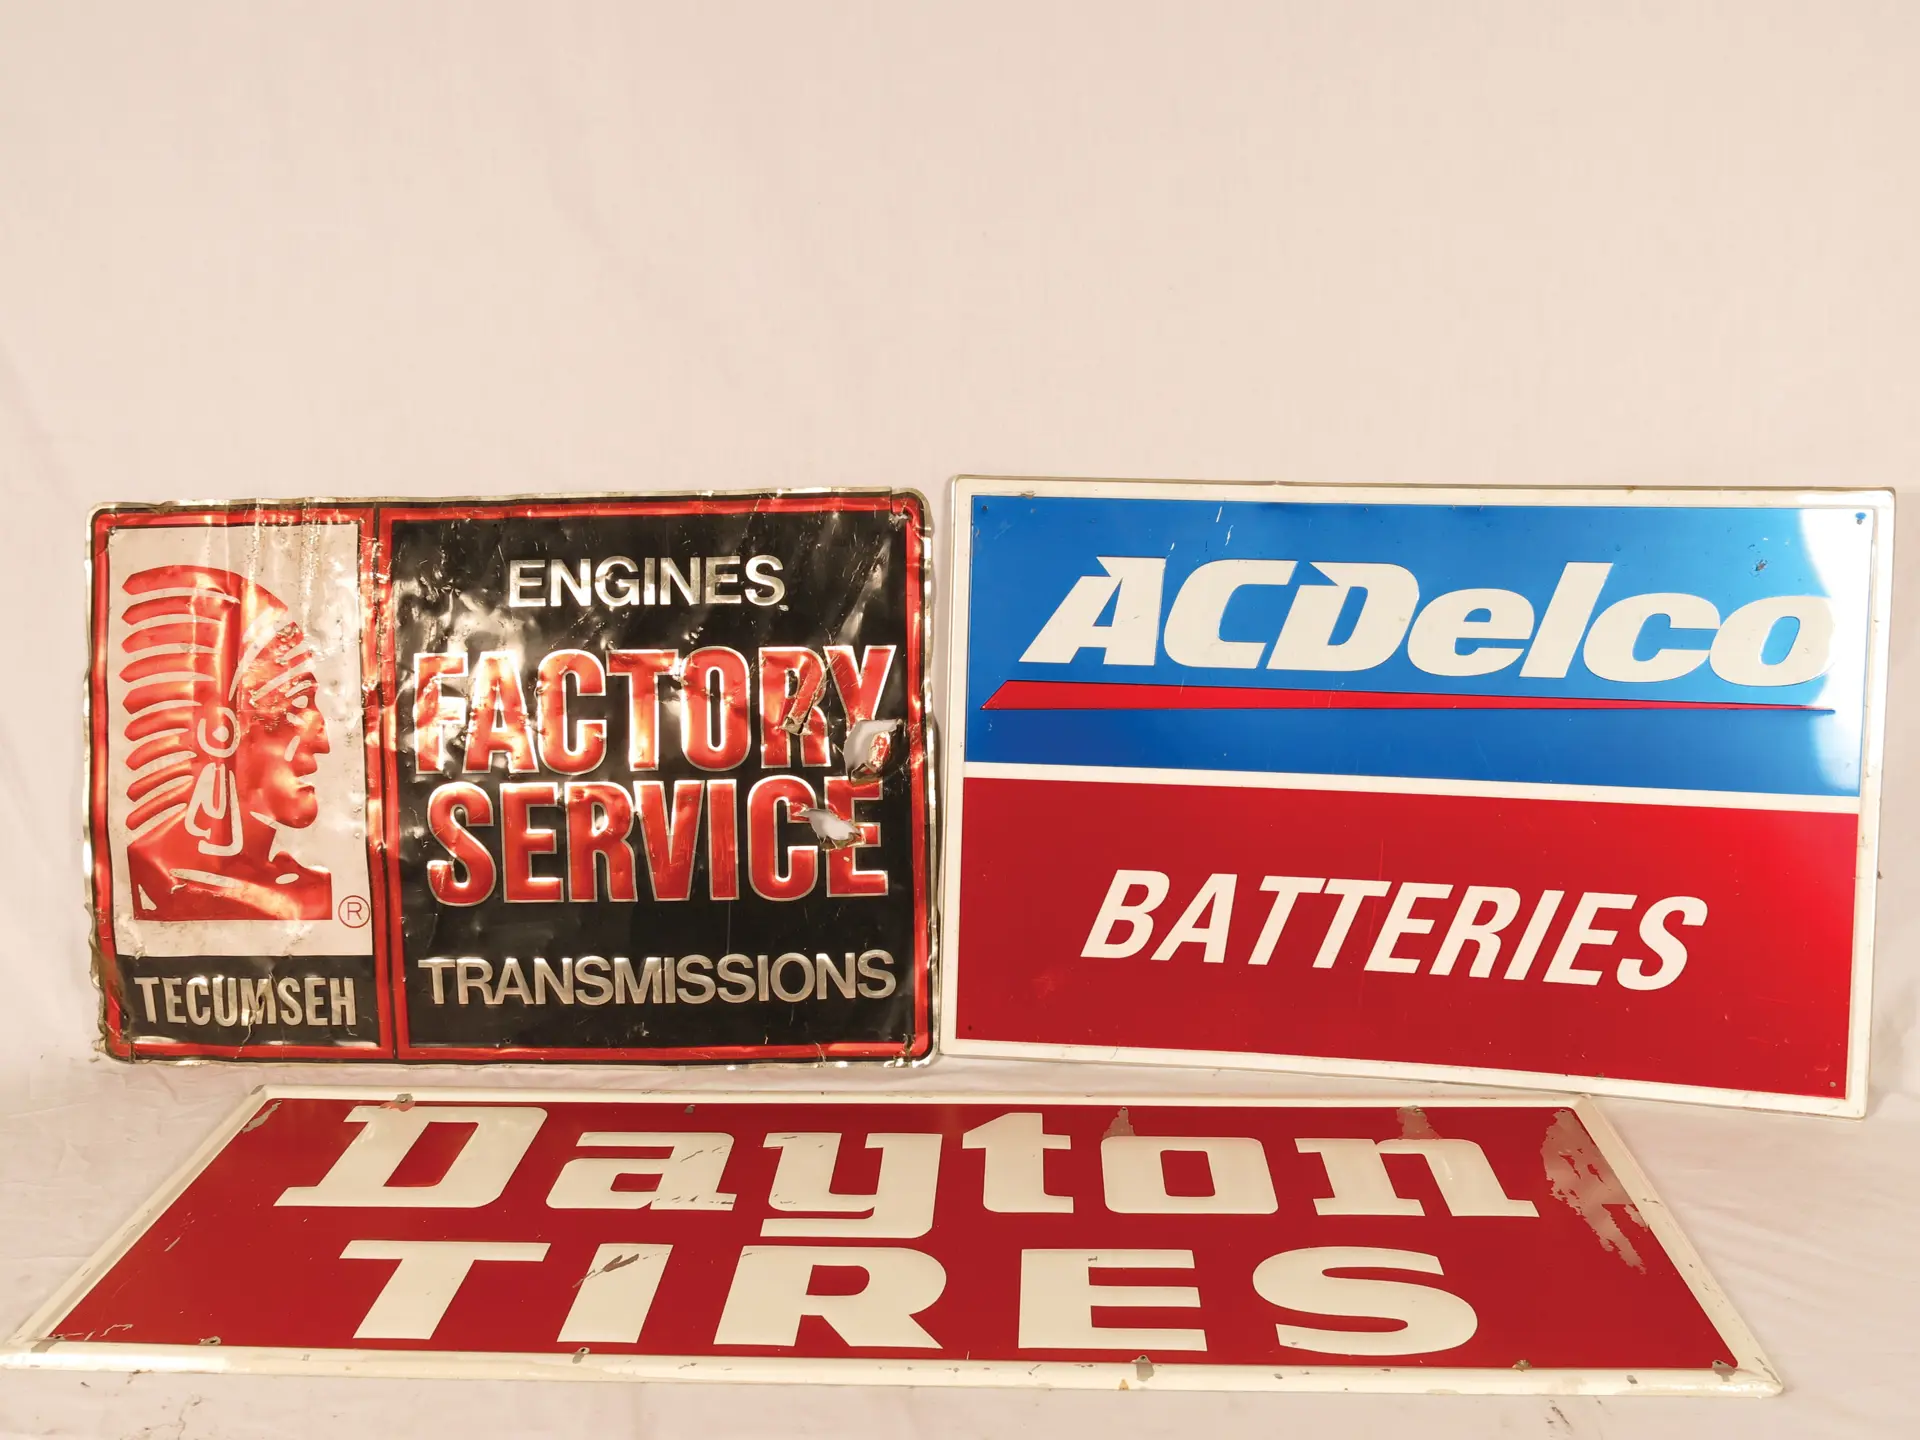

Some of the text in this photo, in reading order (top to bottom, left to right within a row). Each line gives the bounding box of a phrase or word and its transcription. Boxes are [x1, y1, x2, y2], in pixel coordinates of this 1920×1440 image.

[508, 555, 786, 608] ENGINES
[1019, 555, 1836, 688] ACDelco
[413, 645, 897, 775] FACTORY
[427, 775, 889, 907] SERVICE
[418, 950, 897, 1005] TRANSMISSIONS
[1080, 868, 1708, 992] BATTERIES
[134, 974, 357, 1027] TECUMSEH
[274, 1106, 1540, 1240] Dayton
[339, 1239, 1479, 1356] TIRES
